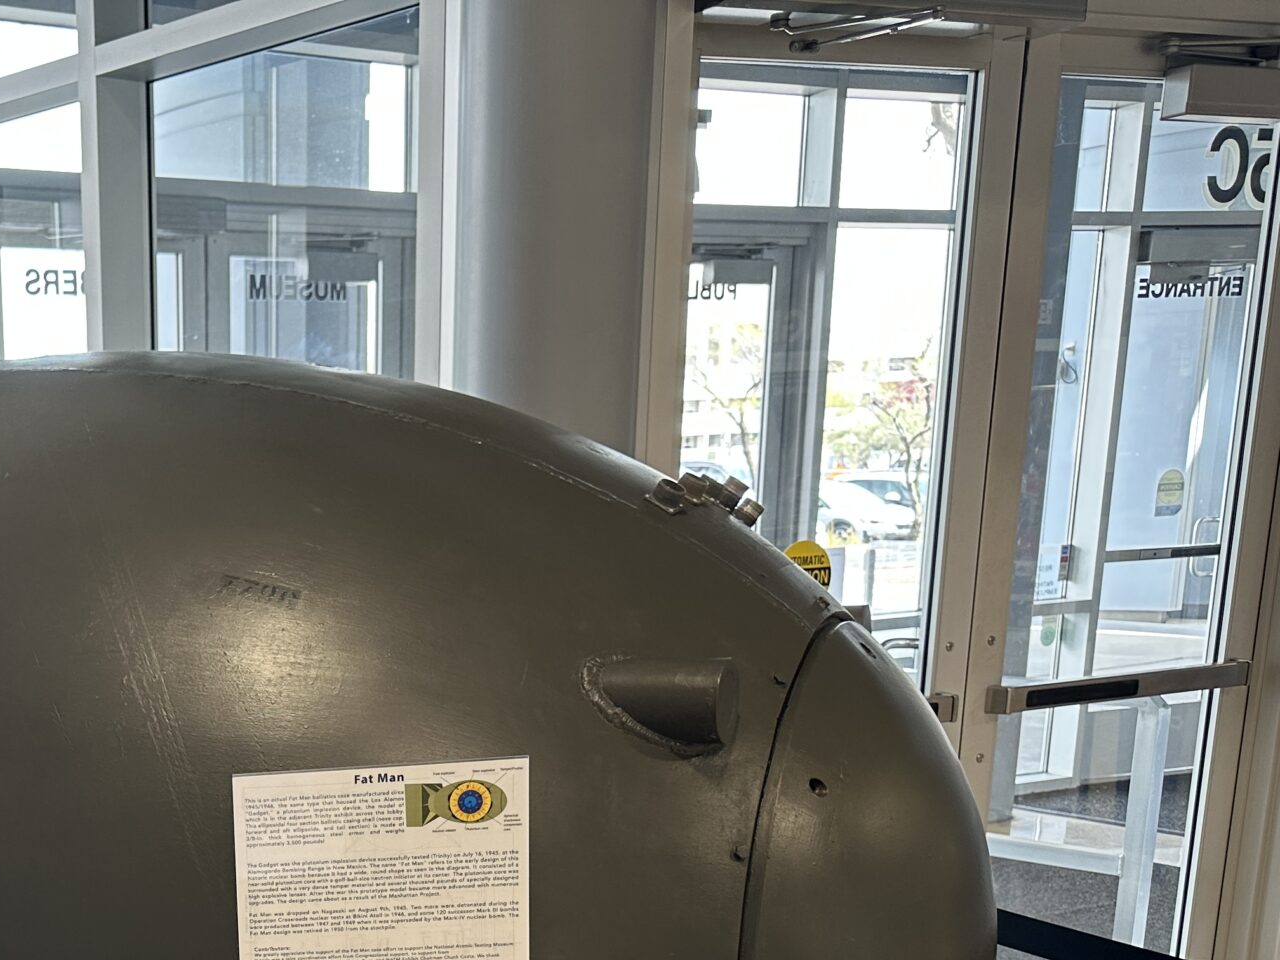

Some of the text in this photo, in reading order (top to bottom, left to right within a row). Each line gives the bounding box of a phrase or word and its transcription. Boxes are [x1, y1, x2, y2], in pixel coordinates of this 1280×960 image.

[790, 554, 825, 566] TOMATIC
[354, 772, 404, 784] Fat Man
